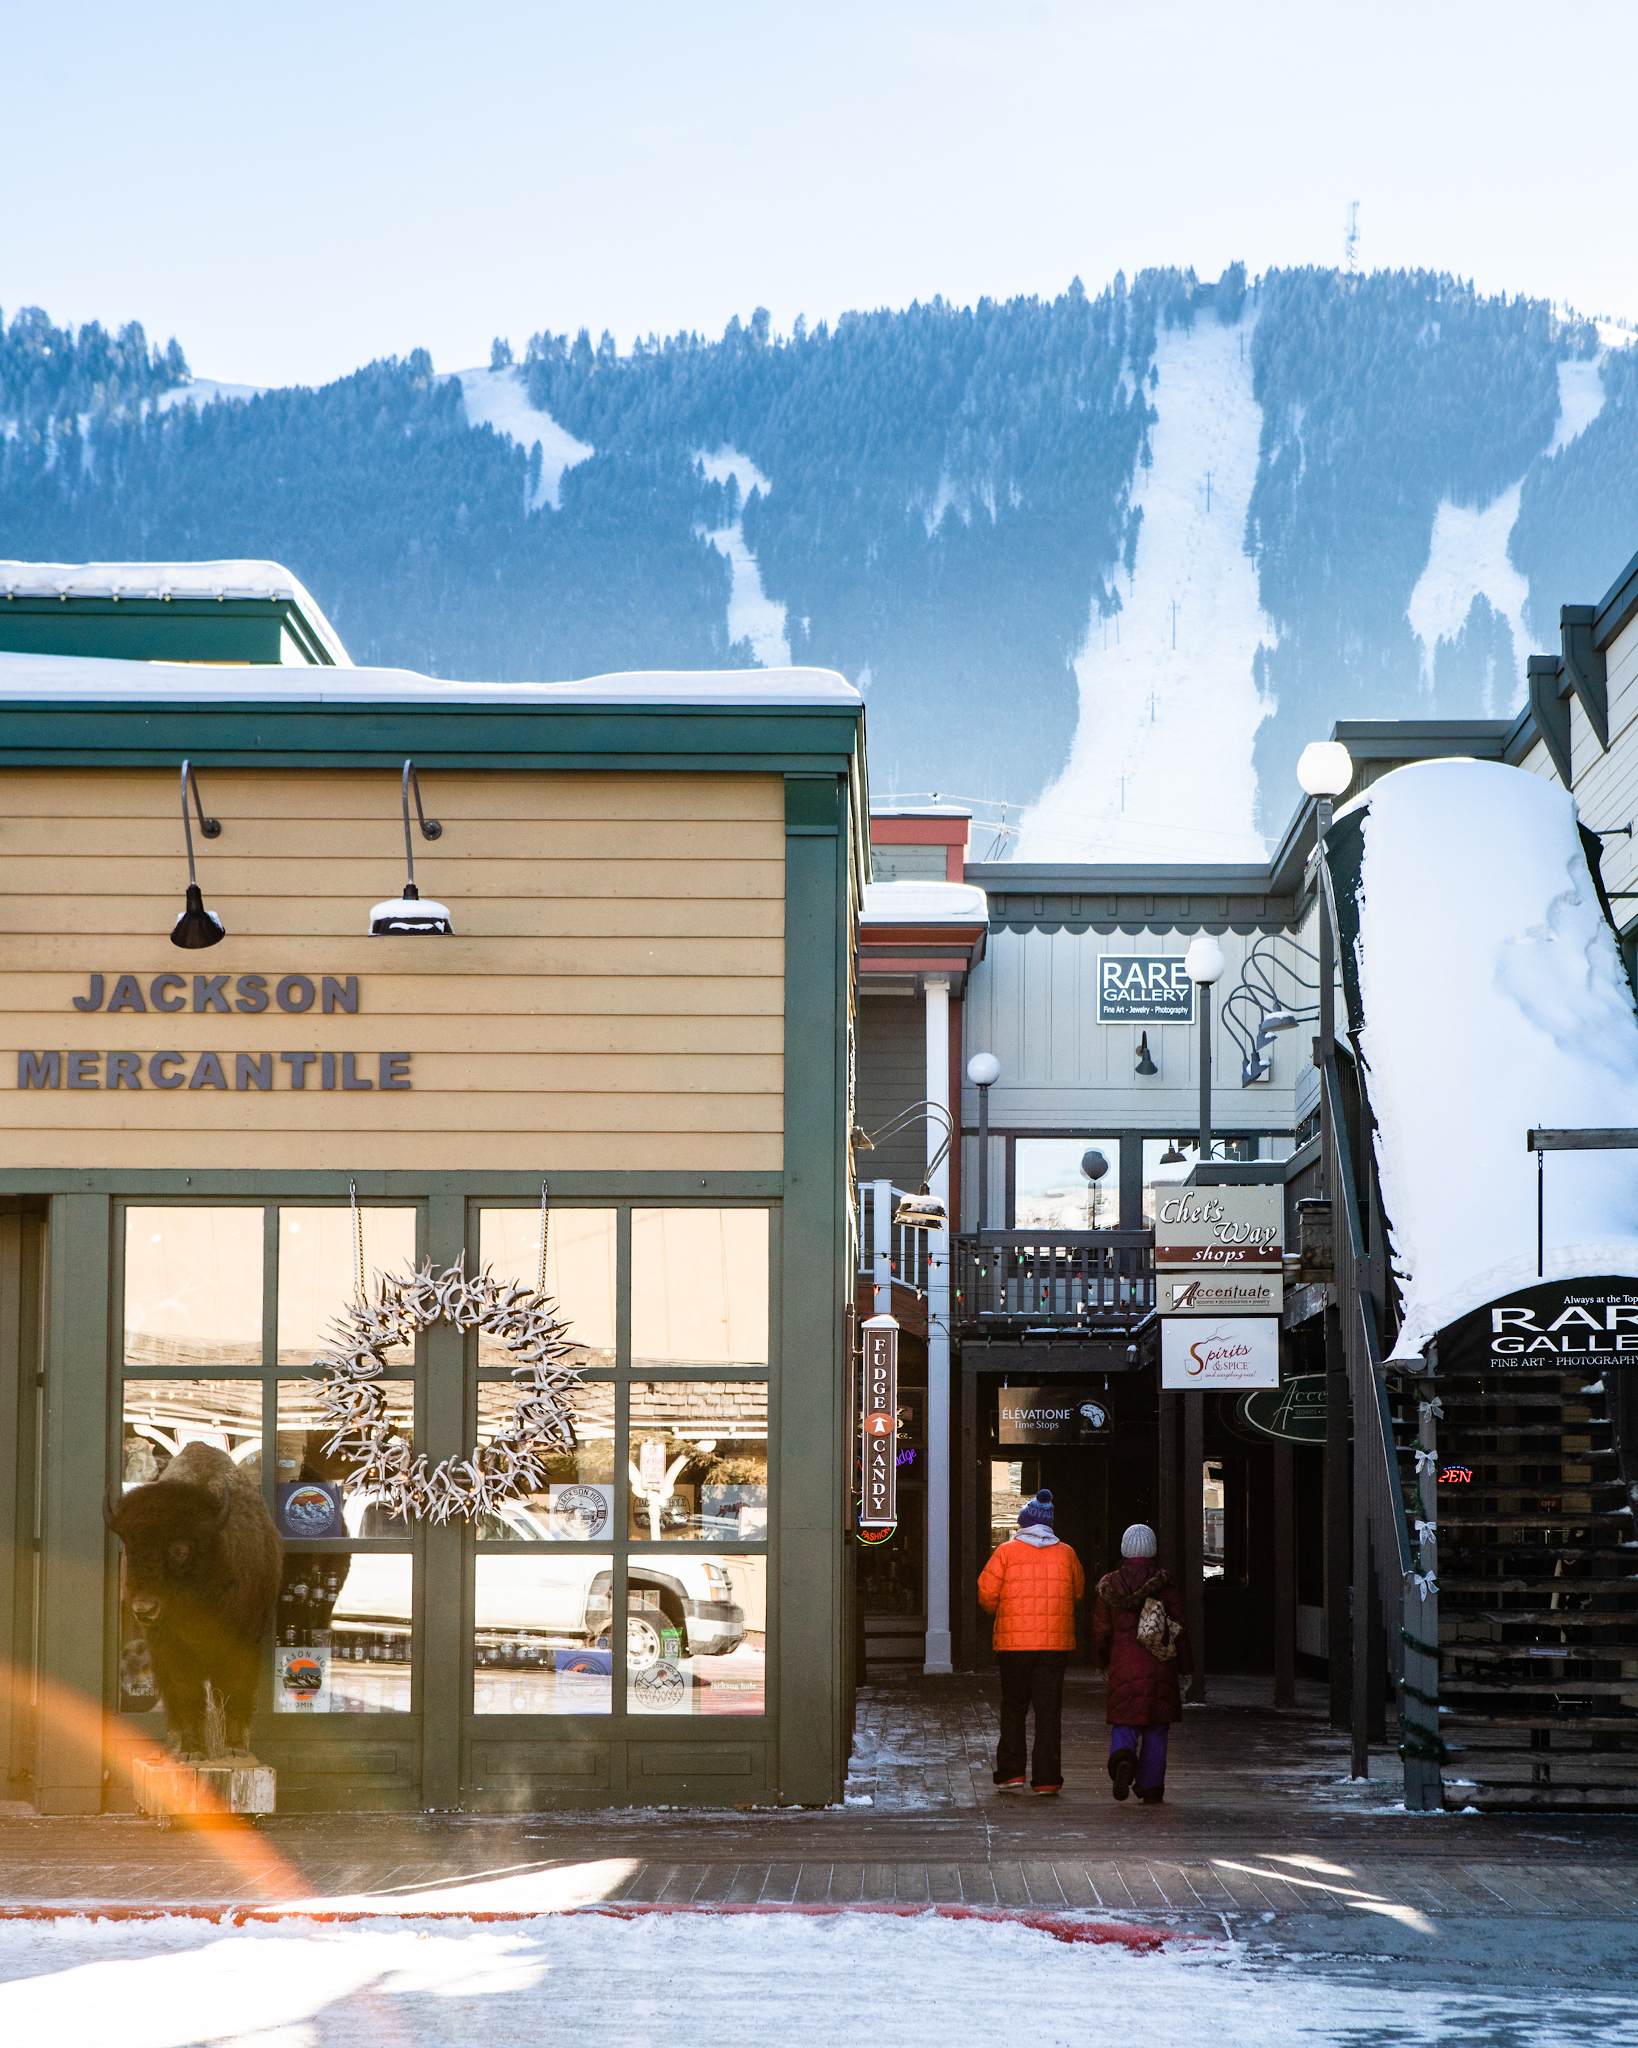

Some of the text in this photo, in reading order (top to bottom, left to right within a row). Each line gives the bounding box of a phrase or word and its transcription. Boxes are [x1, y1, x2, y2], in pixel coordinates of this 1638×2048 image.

[1103, 962, 1189, 989] RARE
[73, 974, 358, 1014] JACKSON
[1103, 989, 1188, 1001] GALLERY
[1129, 1006, 1150, 1015] Jewelry
[1155, 1006, 1188, 1015] Photography
[18, 1051, 412, 1091] MERCANTILE
[1159, 1191, 1224, 1223] Chet's
[1213, 1222, 1277, 1255] Way
[1192, 1243, 1246, 1268] shops
[1169, 1281, 1270, 1311] Accentuate
[1563, 1295, 1594, 1305] Always
[1607, 1295, 1621, 1303] the
[1187, 1342, 1252, 1376] Spirits
[1212, 1361, 1249, 1371] & SPICE
[1491, 1358, 1518, 1368] FINE
[1521, 1357, 1545, 1367] ART
[873, 1339, 887, 1409] FUDGE
[1002, 1407, 1070, 1420] ÉLÉVATIONE
[1014, 1421, 1059, 1430] Time Stops
[872, 1439, 886, 1510] CANDY
[1437, 1470, 1473, 1483] PEN
[559, 1488, 589, 1509] JACKSON
[710, 1682, 757, 1691] jackson hole
